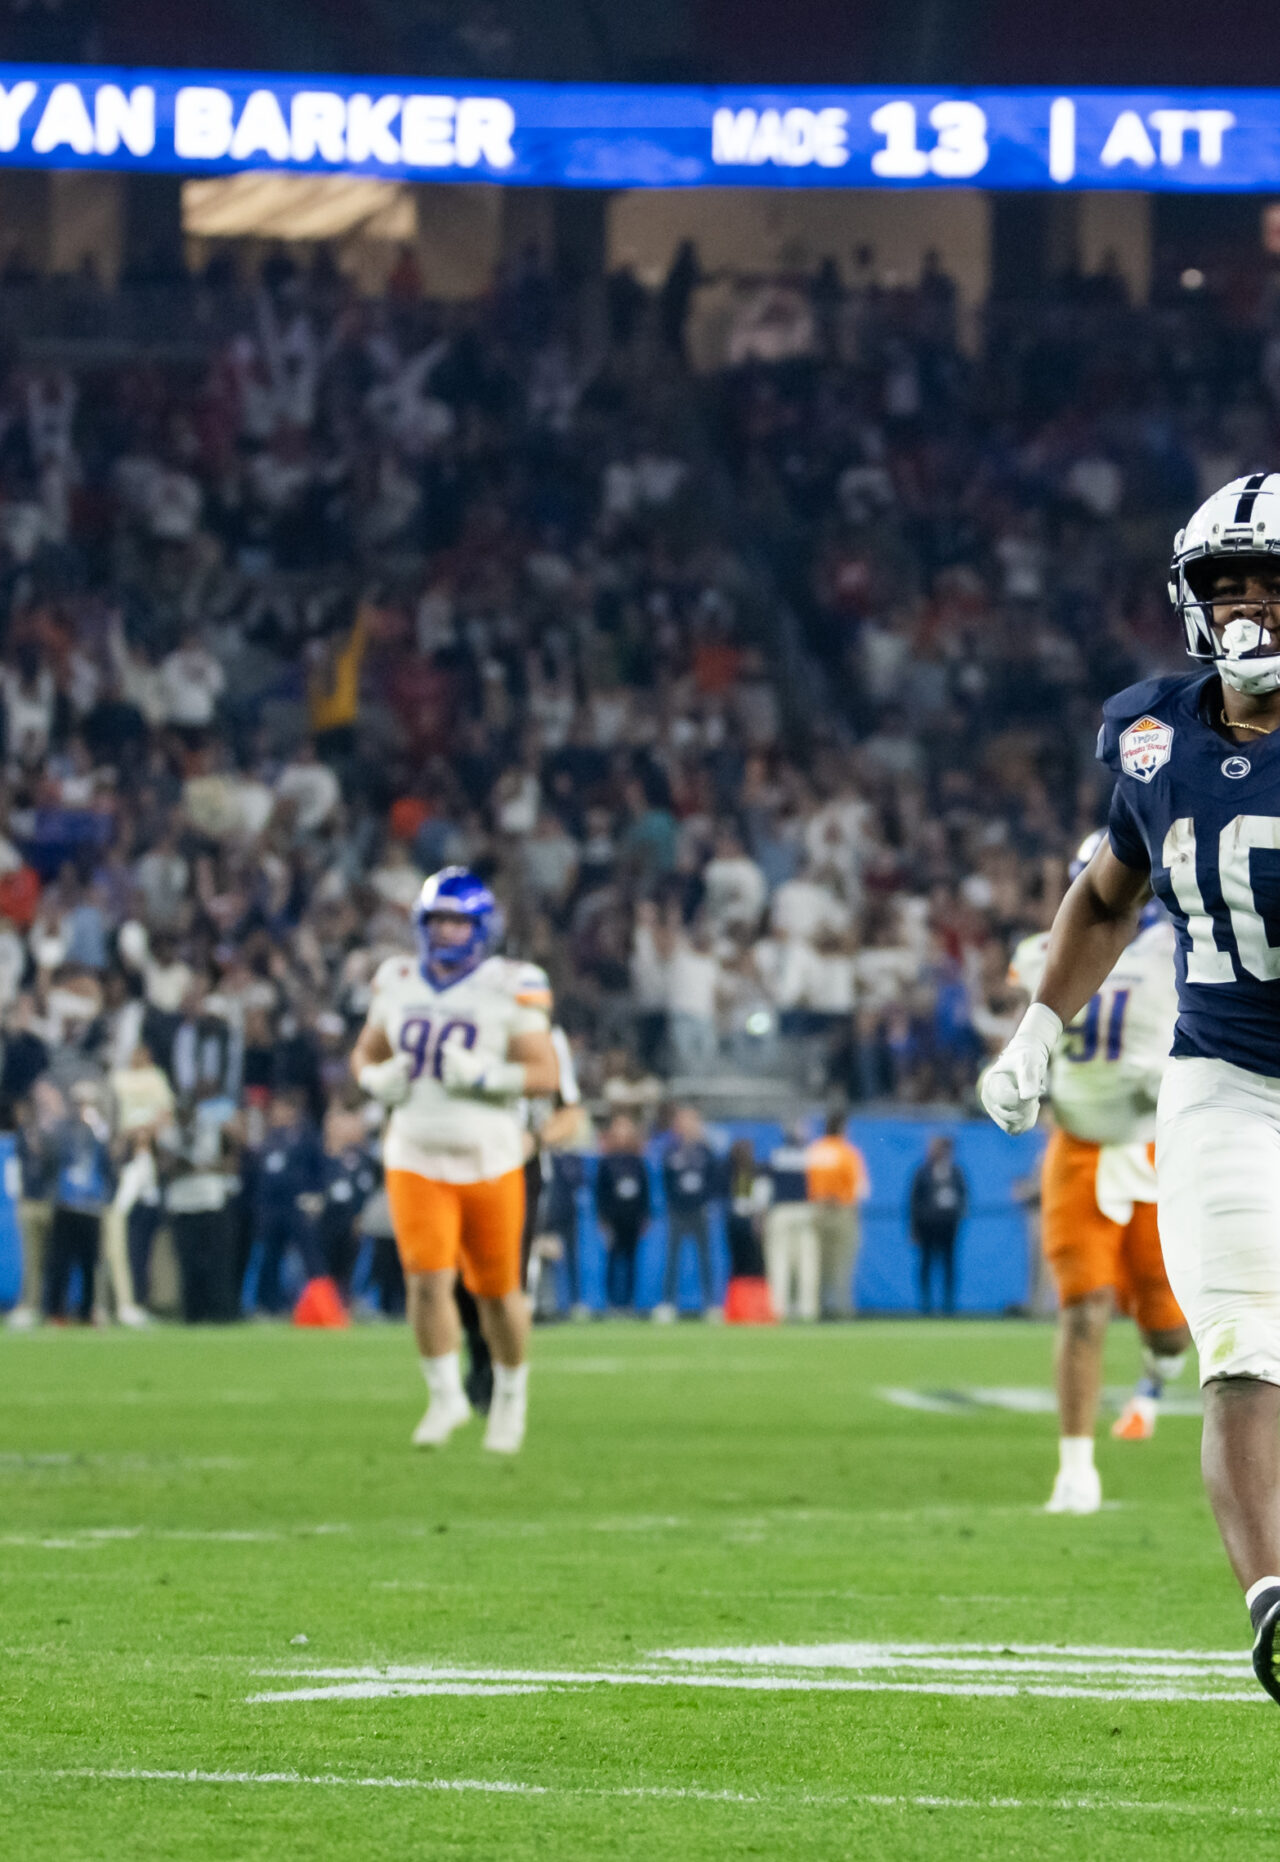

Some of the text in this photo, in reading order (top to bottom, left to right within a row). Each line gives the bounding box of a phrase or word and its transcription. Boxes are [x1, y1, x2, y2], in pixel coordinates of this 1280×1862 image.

[174, 86, 515, 168] BARKER
[712, 101, 988, 178] MADE 13
[1100, 109, 1235, 168] ATT
